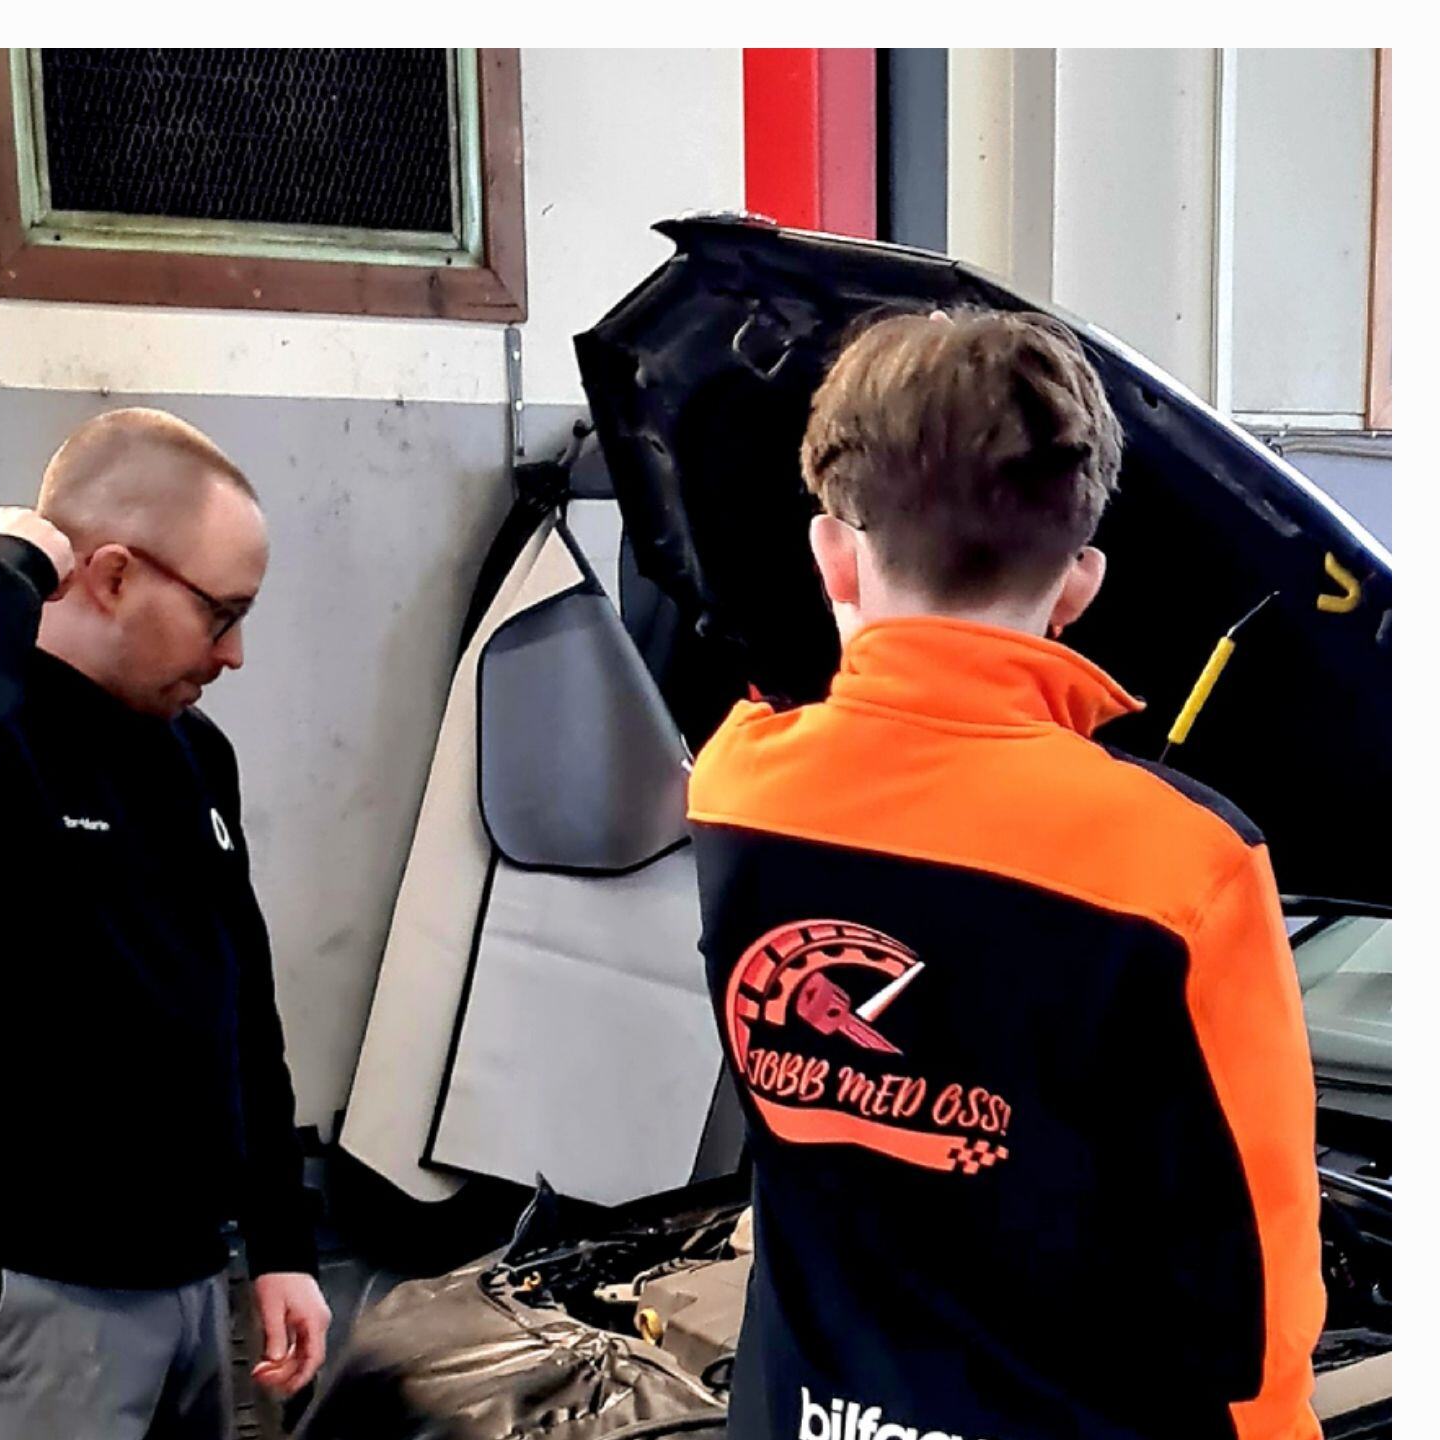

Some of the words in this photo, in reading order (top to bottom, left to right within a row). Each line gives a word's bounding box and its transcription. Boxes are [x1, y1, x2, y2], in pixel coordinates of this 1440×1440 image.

[747, 1048, 830, 1102] JOBB
[837, 1066, 927, 1119] MED
[932, 1083, 1011, 1137] OSS!
